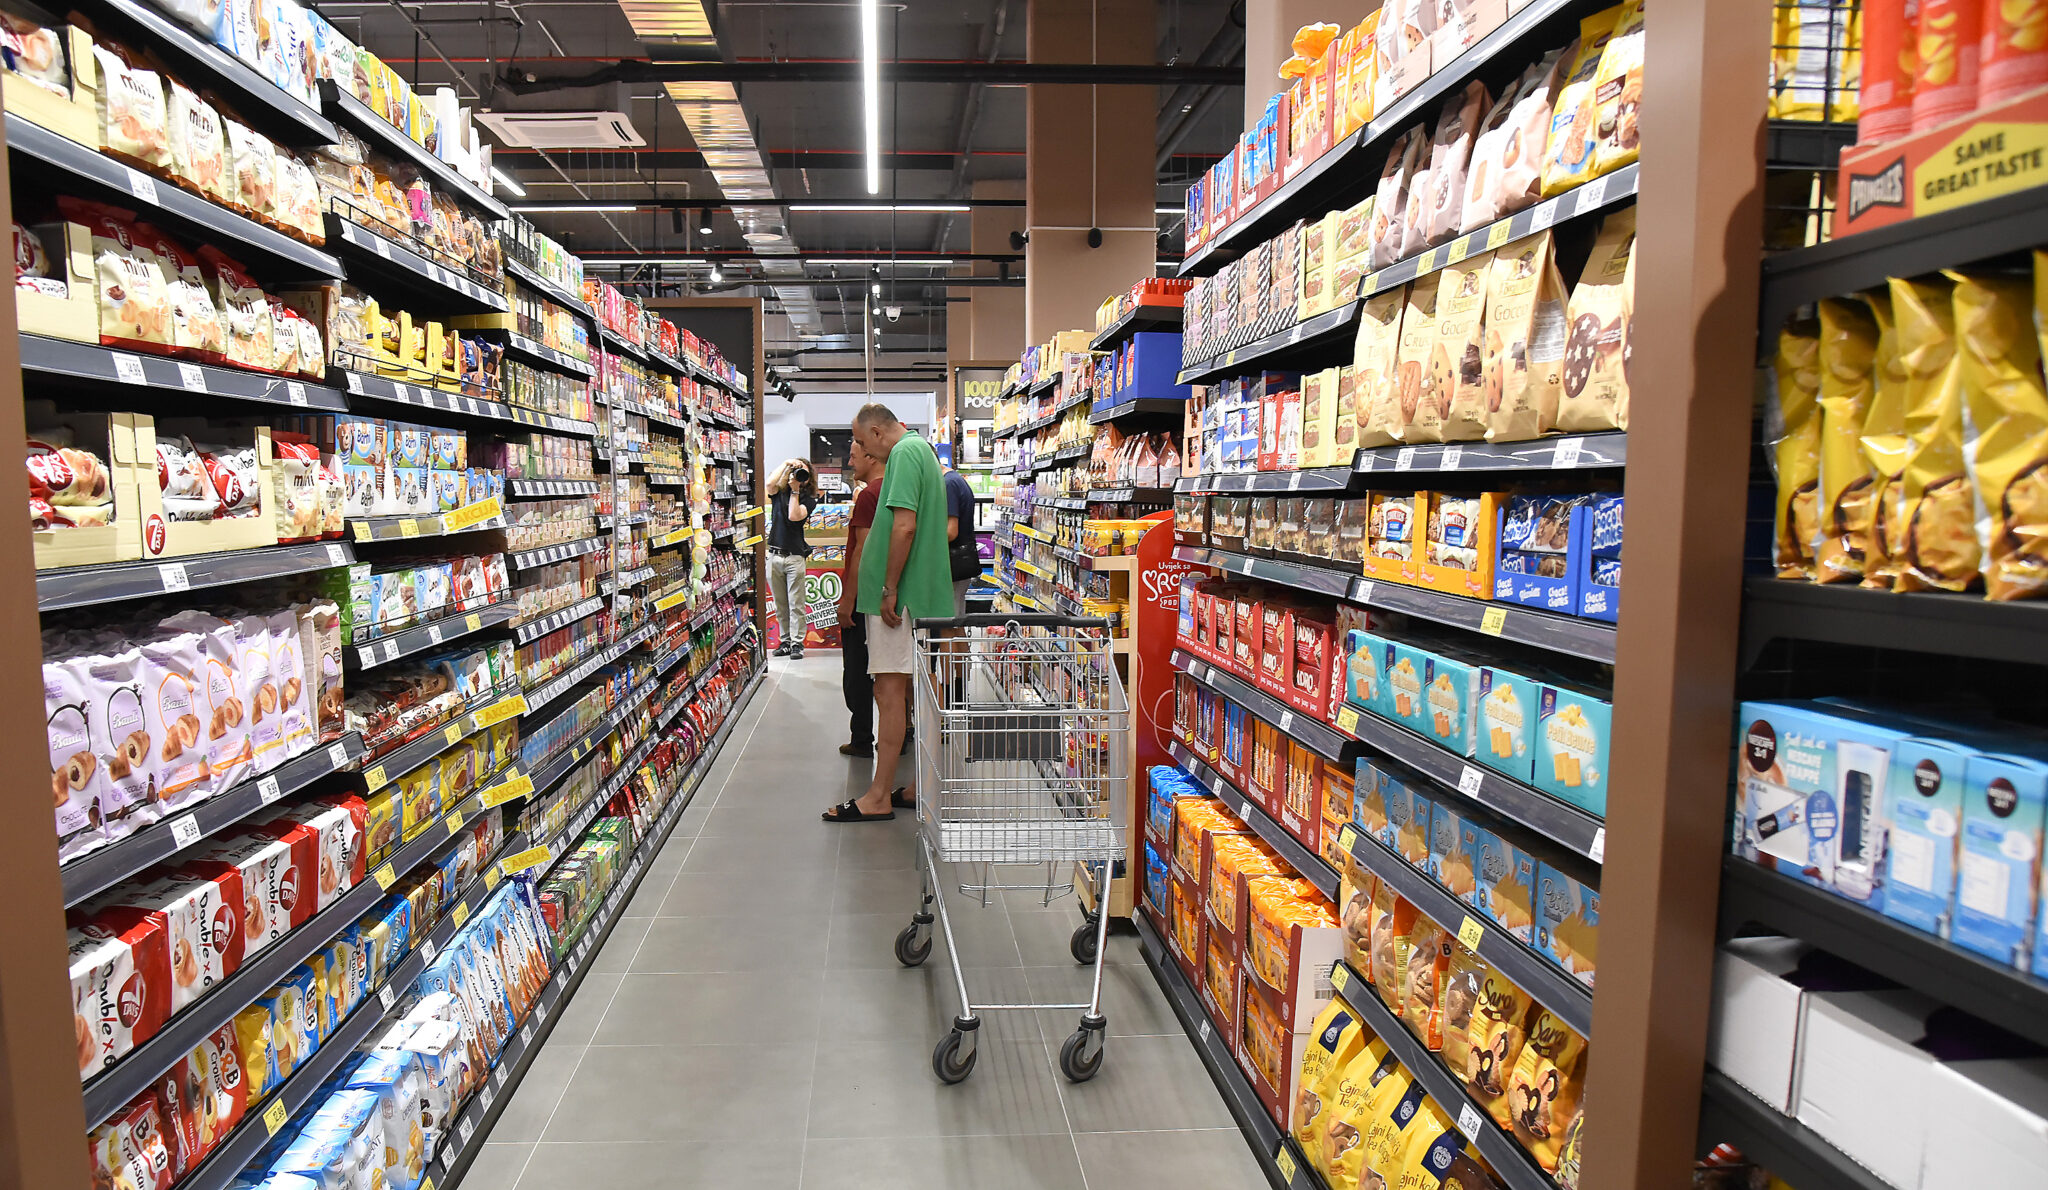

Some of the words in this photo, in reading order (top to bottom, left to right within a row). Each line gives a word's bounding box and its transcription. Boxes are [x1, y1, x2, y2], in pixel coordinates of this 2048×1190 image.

[1955, 132, 2005, 164] SAME
[1924, 168, 1980, 199] GREAT
[1986, 148, 2043, 179] TASTE
[965, 380, 1001, 397] 100%
[455, 501, 500, 526] AKCIJA
[147, 518, 160, 551] 7
[155, 522, 164, 549] DAYS
[1158, 561, 1182, 573] Uvijek
[805, 572, 842, 603] 30
[811, 599, 832, 612] YEARS
[162, 694, 189, 712] Bauli
[484, 698, 525, 722] AKCIJA
[112, 709, 140, 729] Bauli
[51, 728, 84, 751] Bauli
[492, 779, 533, 803] AKCIJA
[511, 848, 550, 871] AKCIJA
[268, 855, 279, 914] Double
[281, 868, 298, 891] 7
[281, 890, 297, 904] DAYS
[199, 891, 212, 959] Double
[213, 908, 230, 933] 7
[214, 930, 229, 946] DAYS
[270, 929, 280, 941] 6
[121, 972, 141, 1002] 7
[202, 974, 214, 988] 6
[99, 956, 118, 1037] Double
[1478, 978, 1513, 1009] Sara
[122, 1002, 140, 1018] DAYS
[303, 984, 317, 1028] B&B
[1529, 1013, 1566, 1043] Sara
[103, 1054, 117, 1067] 6
[133, 1116, 170, 1172] B&B
[1399, 1171, 1420, 1188] ajni
